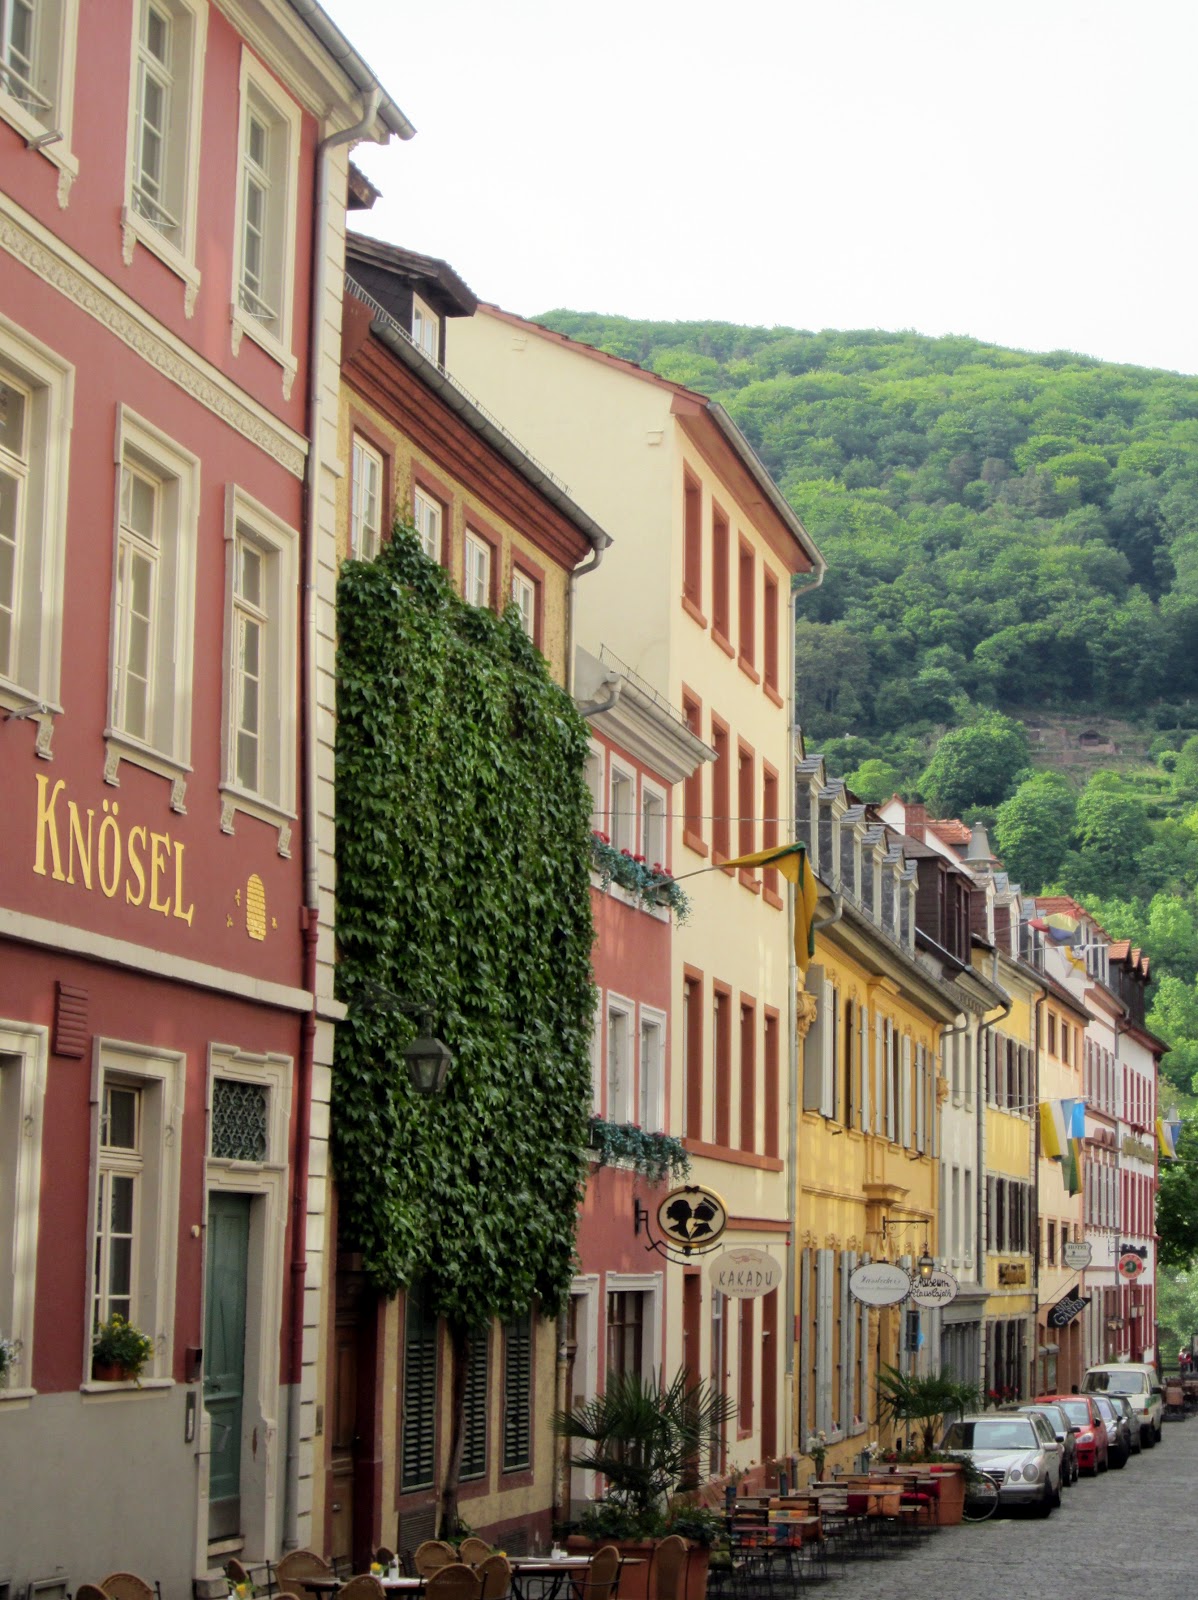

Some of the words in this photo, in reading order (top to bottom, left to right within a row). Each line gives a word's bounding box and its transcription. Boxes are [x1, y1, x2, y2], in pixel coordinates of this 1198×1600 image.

[33, 773, 194, 927] KNÖSEL
[719, 1270, 772, 1287] KAKADU
[1053, 1297, 1086, 1325] GARTEN
[1054, 1296, 1073, 1313] BIER
